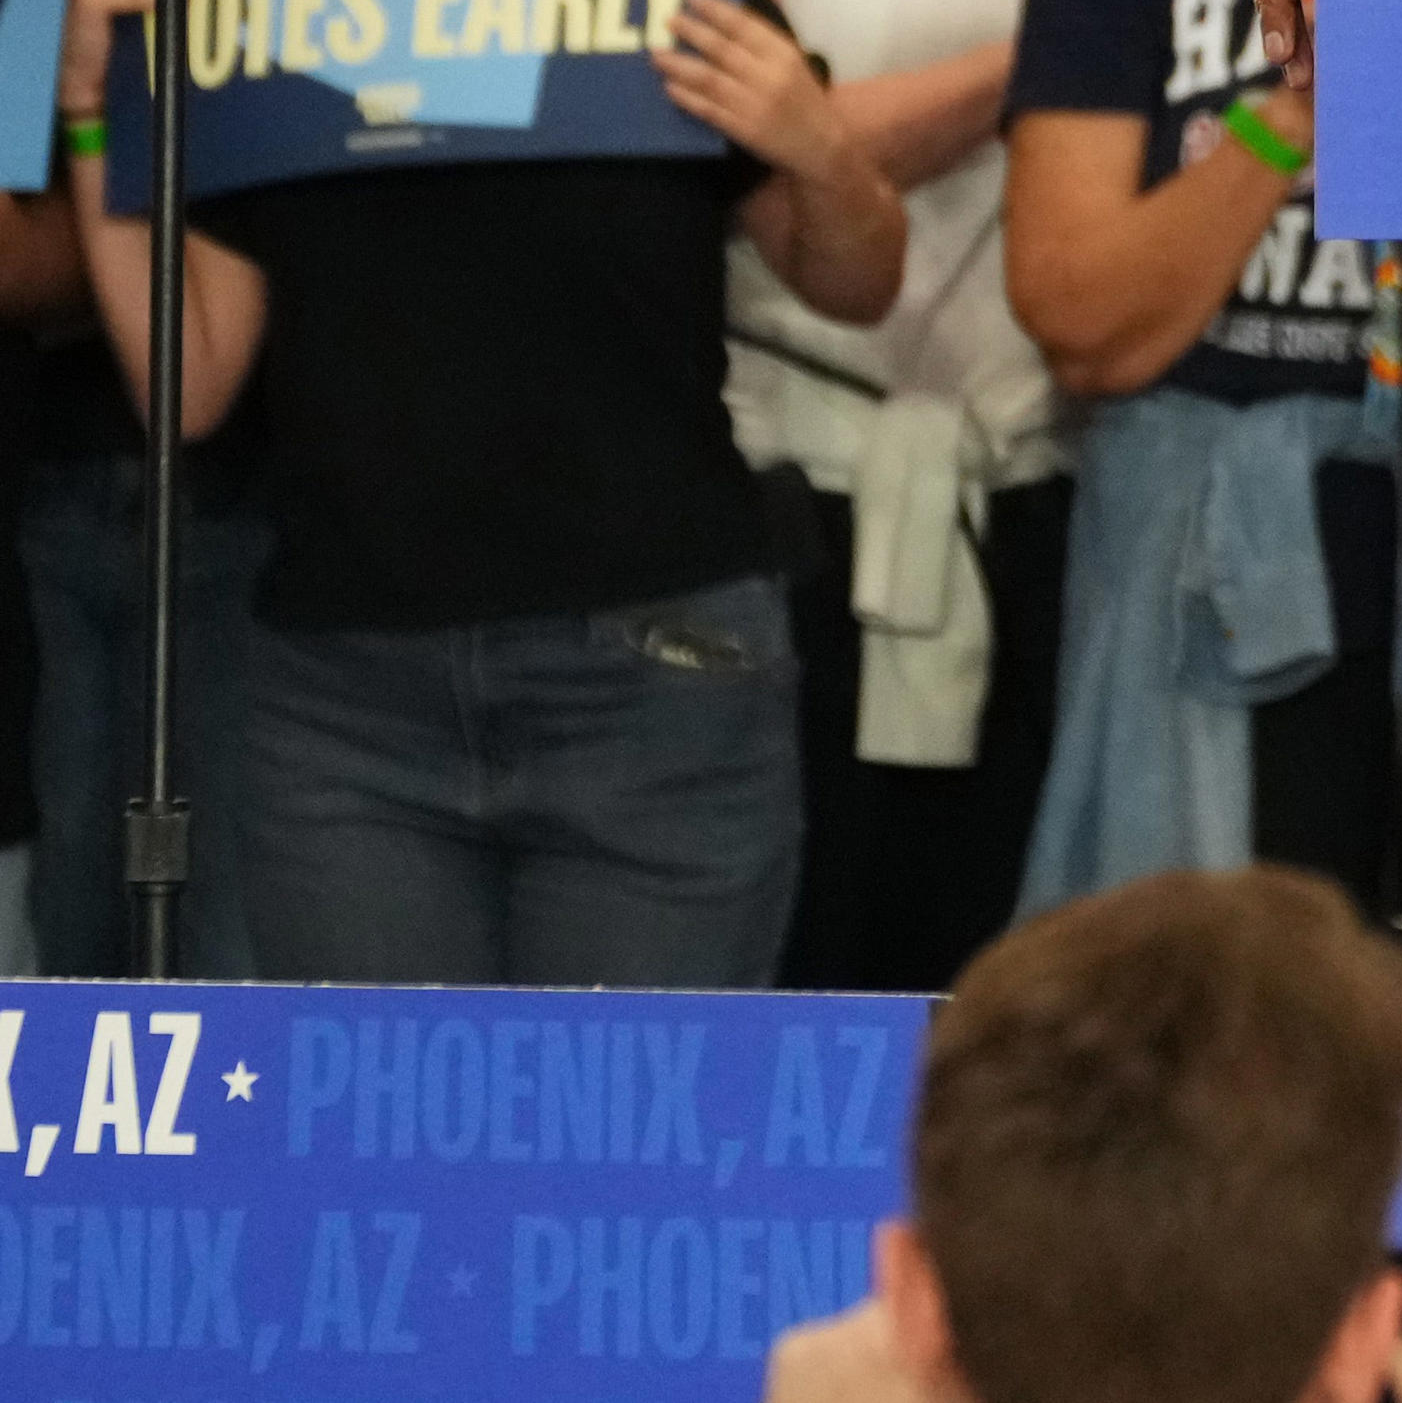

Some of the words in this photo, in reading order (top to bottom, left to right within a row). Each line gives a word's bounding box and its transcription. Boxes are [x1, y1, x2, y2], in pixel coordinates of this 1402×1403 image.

[74, 1012, 201, 1155] AZ
[287, 1015, 746, 1189] PHOENIX,
[765, 1025, 890, 1169] AZ
[299, 1211, 424, 1354] AZ
[511, 1214, 874, 1361] PHOENI
